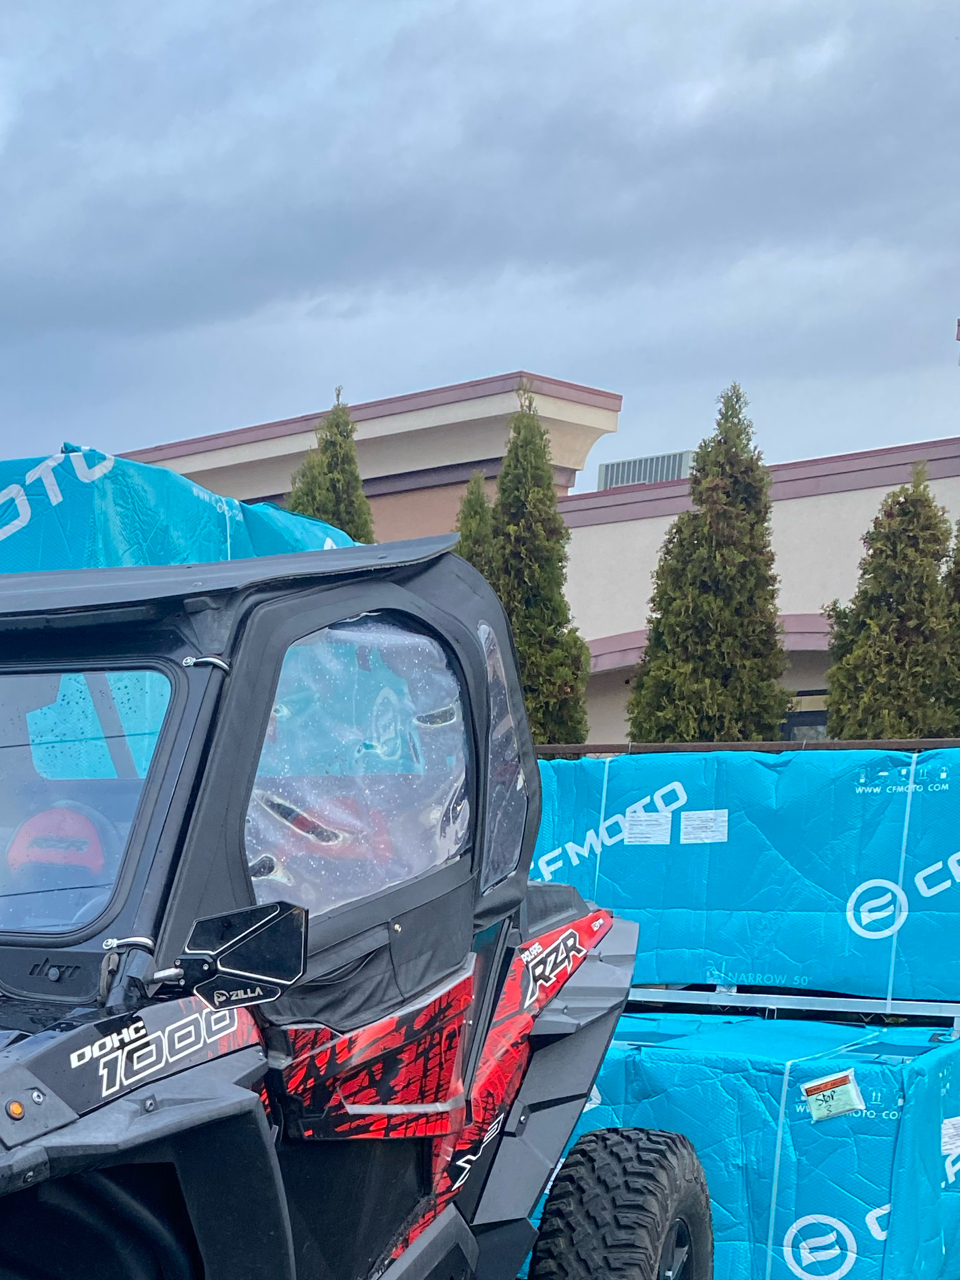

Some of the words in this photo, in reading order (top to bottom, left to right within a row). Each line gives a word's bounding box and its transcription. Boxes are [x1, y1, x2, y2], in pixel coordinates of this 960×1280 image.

[530, 781, 688, 882] FMOTO
[229, 986, 264, 1000] ZILLA
[524, 928, 588, 1009] RZR
[728, 972, 787, 984] NARROW
[70, 1020, 147, 1069] DOHC
[98, 1007, 239, 1097] 1000
